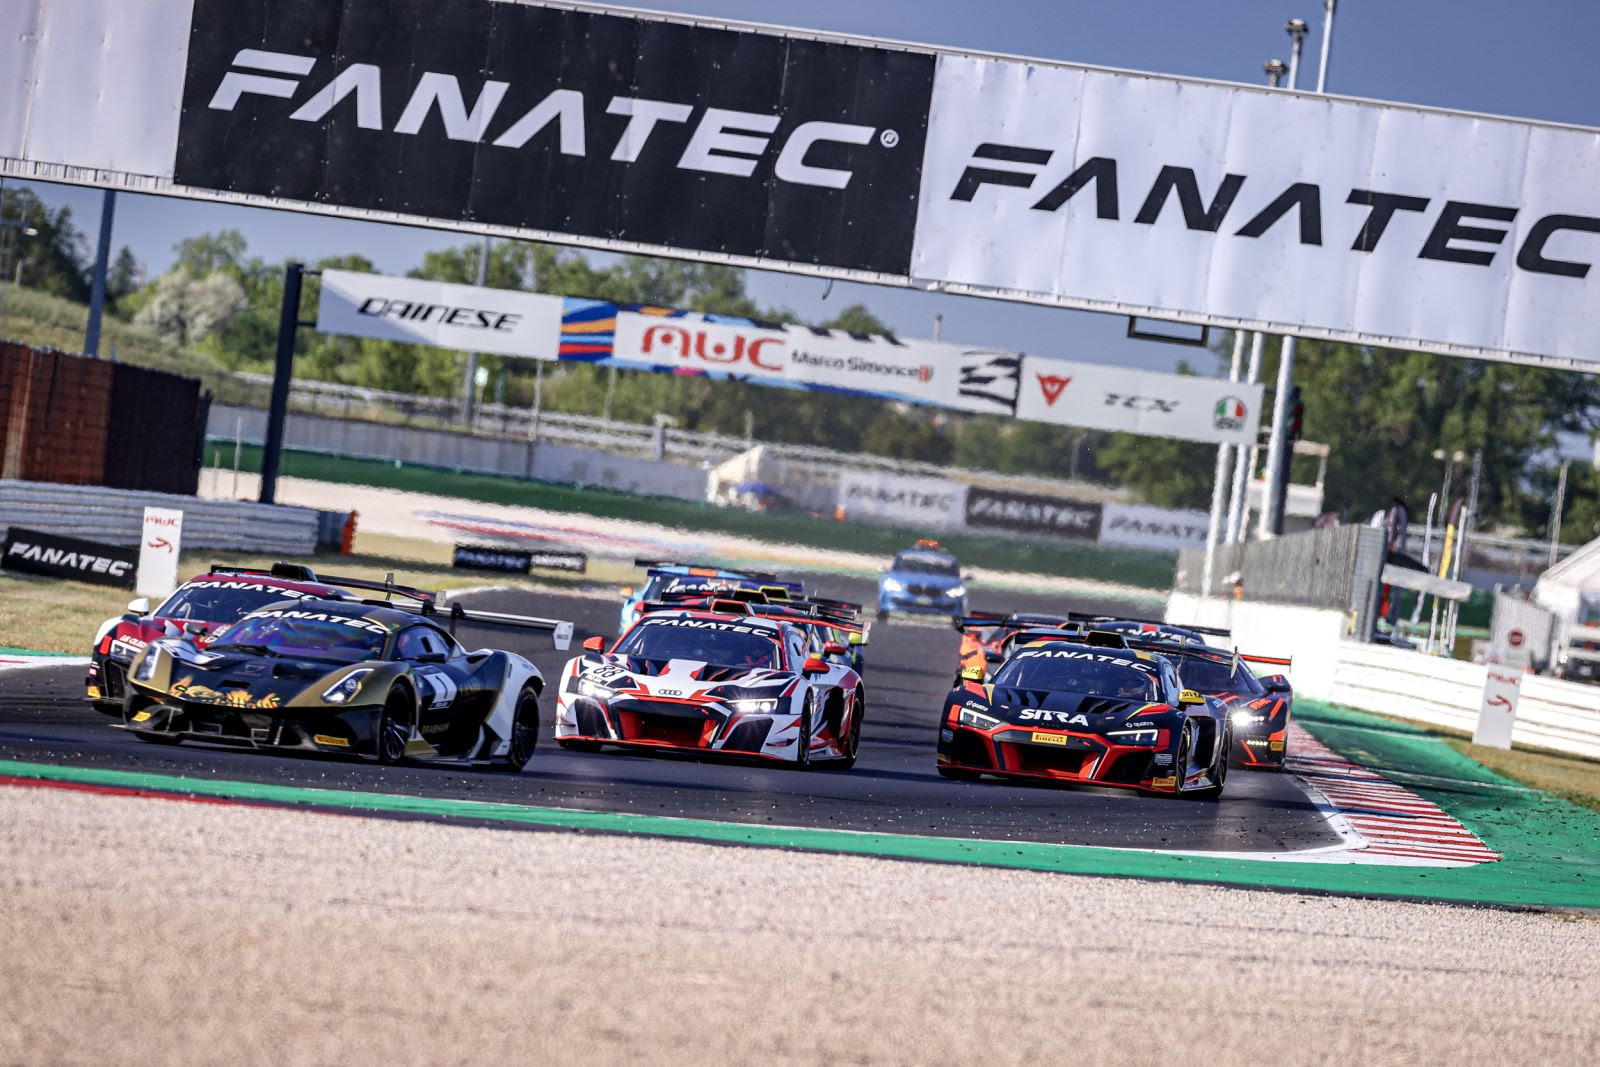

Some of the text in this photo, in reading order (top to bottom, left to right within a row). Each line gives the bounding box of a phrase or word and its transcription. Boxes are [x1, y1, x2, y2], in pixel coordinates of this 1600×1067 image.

[207, 48, 877, 190] FANATEC
[950, 142, 1600, 279] FANATEC
[357, 297, 524, 334] DAINESE
[791, 349, 845, 370] Marco
[969, 497, 1097, 529] FANATEC
[1109, 516, 1208, 541] FANAT
[8, 541, 127, 577] FANATEC
[182, 580, 323, 601] FANATEC
[241, 609, 386, 635] FANATEC
[643, 618, 771, 637] FANATEC
[1016, 650, 1152, 672] FANATEC
[1035, 734, 1064, 743] PIRELLI
